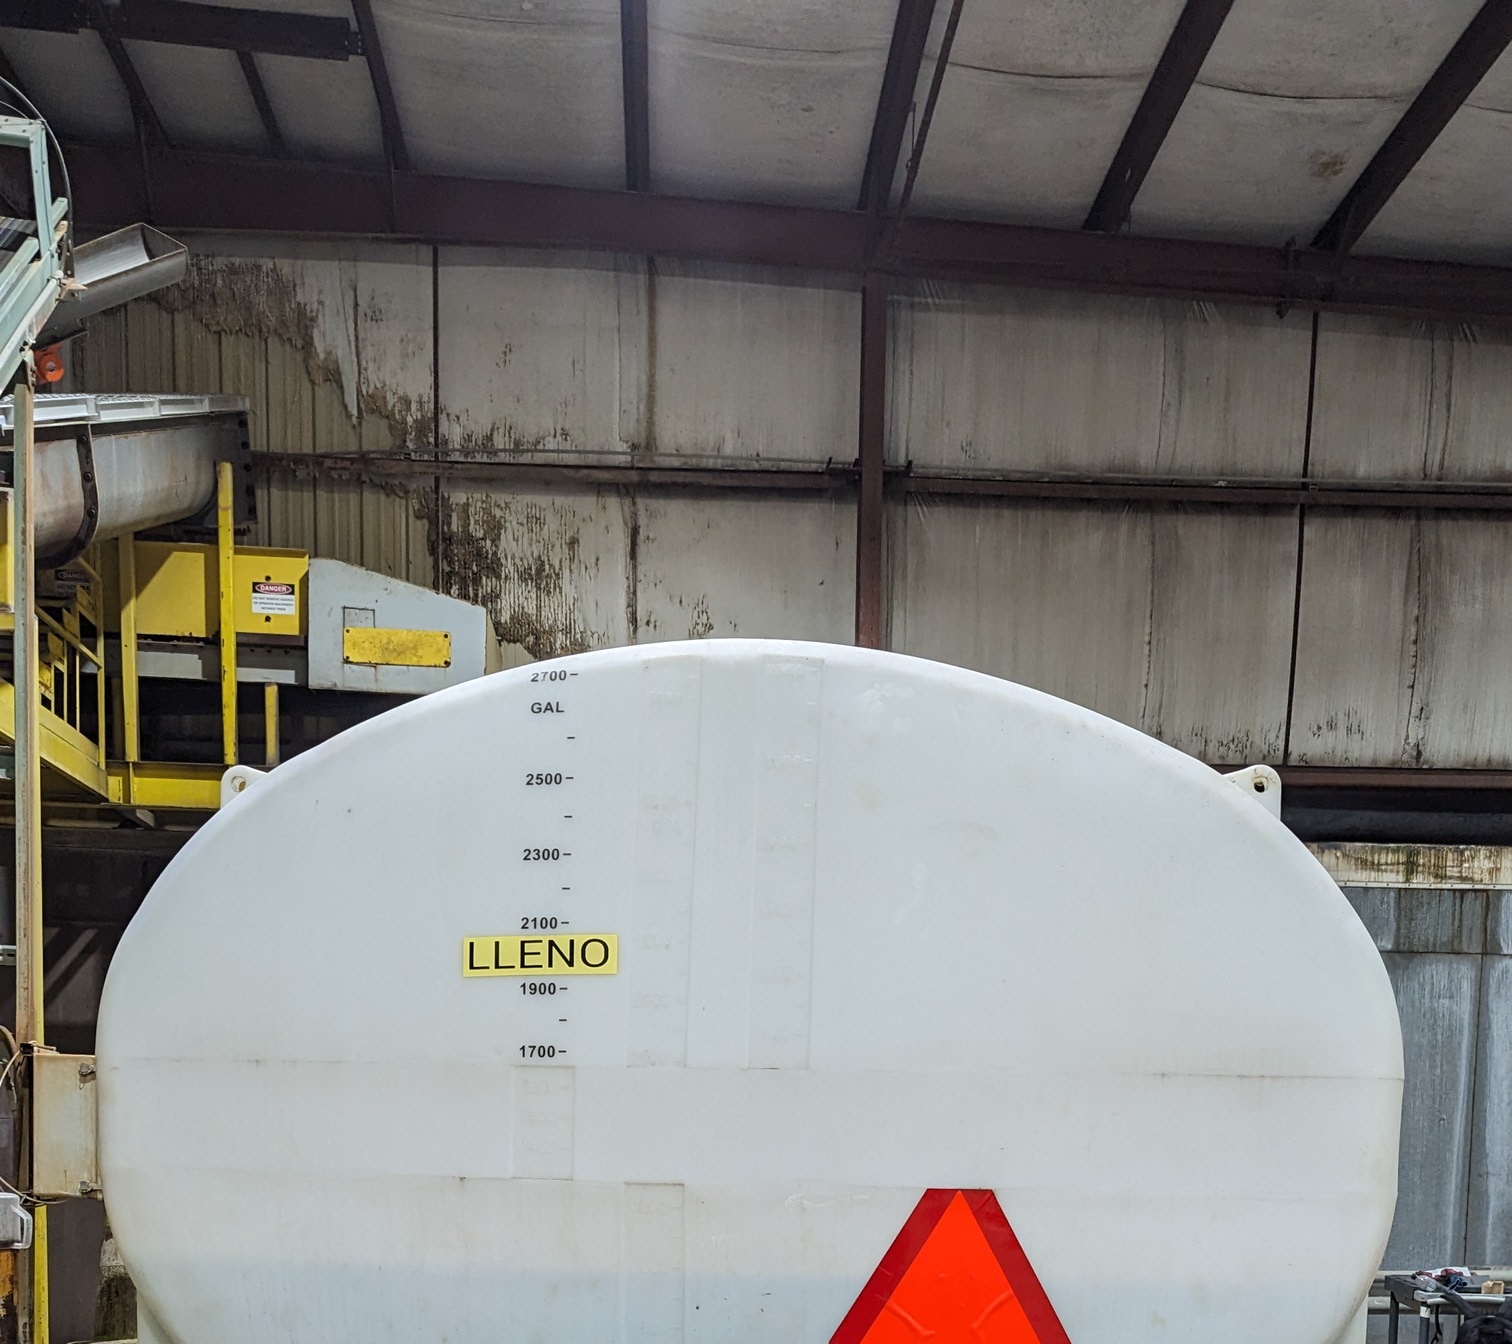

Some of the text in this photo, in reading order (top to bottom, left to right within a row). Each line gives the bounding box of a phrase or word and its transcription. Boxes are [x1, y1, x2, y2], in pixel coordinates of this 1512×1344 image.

[530, 670, 567, 682] 2700
[530, 701, 565, 714] GAL
[525, 772, 563, 786] 2500
[522, 848, 560, 861] 2300
[520, 916, 558, 930] 2100
[468, 938, 610, 970] LLENO
[519, 982, 557, 995] 1900
[518, 1045, 556, 1058] 1700
